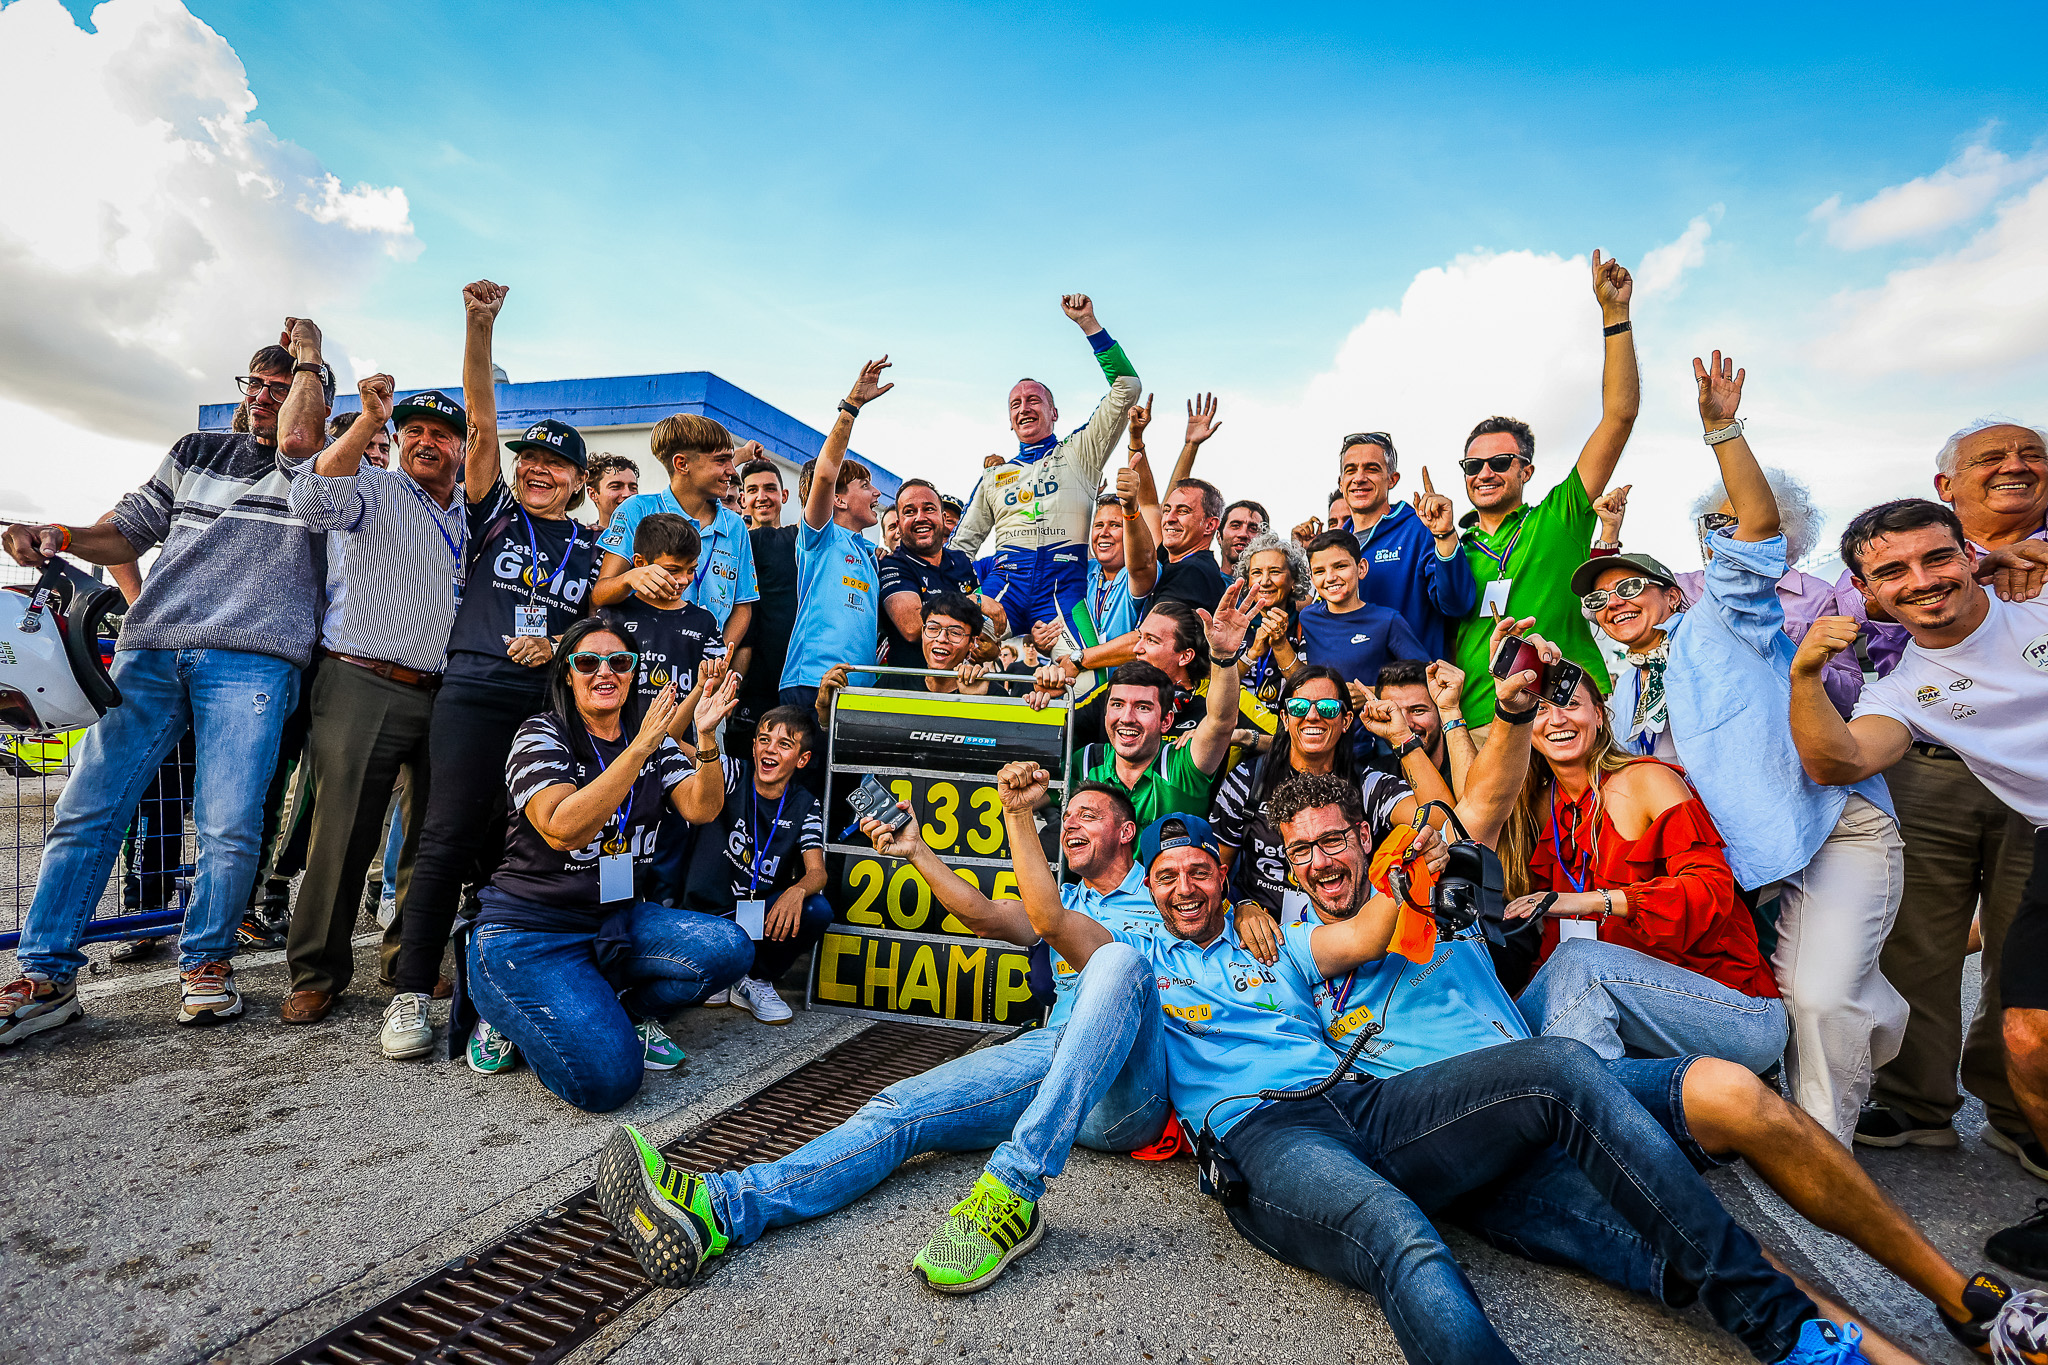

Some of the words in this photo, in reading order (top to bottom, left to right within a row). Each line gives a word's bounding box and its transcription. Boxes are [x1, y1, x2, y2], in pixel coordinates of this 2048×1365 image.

[526, 431, 564, 447] Gold
[1004, 481, 1059, 506] GOLD
[493, 551, 588, 604] Gold
[843, 577, 868, 591] DOCU
[492, 580, 529, 597] PetroGold
[560, 601, 578, 615] Team
[639, 650, 667, 662] etro
[1917, 690, 1941, 702] FPAK
[910, 731, 966, 744] CHEFO
[966, 737, 995, 745] SPORT
[1254, 838, 1286, 858] Pet
[818, 933, 1033, 1023] CHAMP
[1409, 948, 1455, 988] Extremadura
[1164, 1007, 1209, 1019] DOCU
[1329, 1009, 1369, 1038] DOCU
